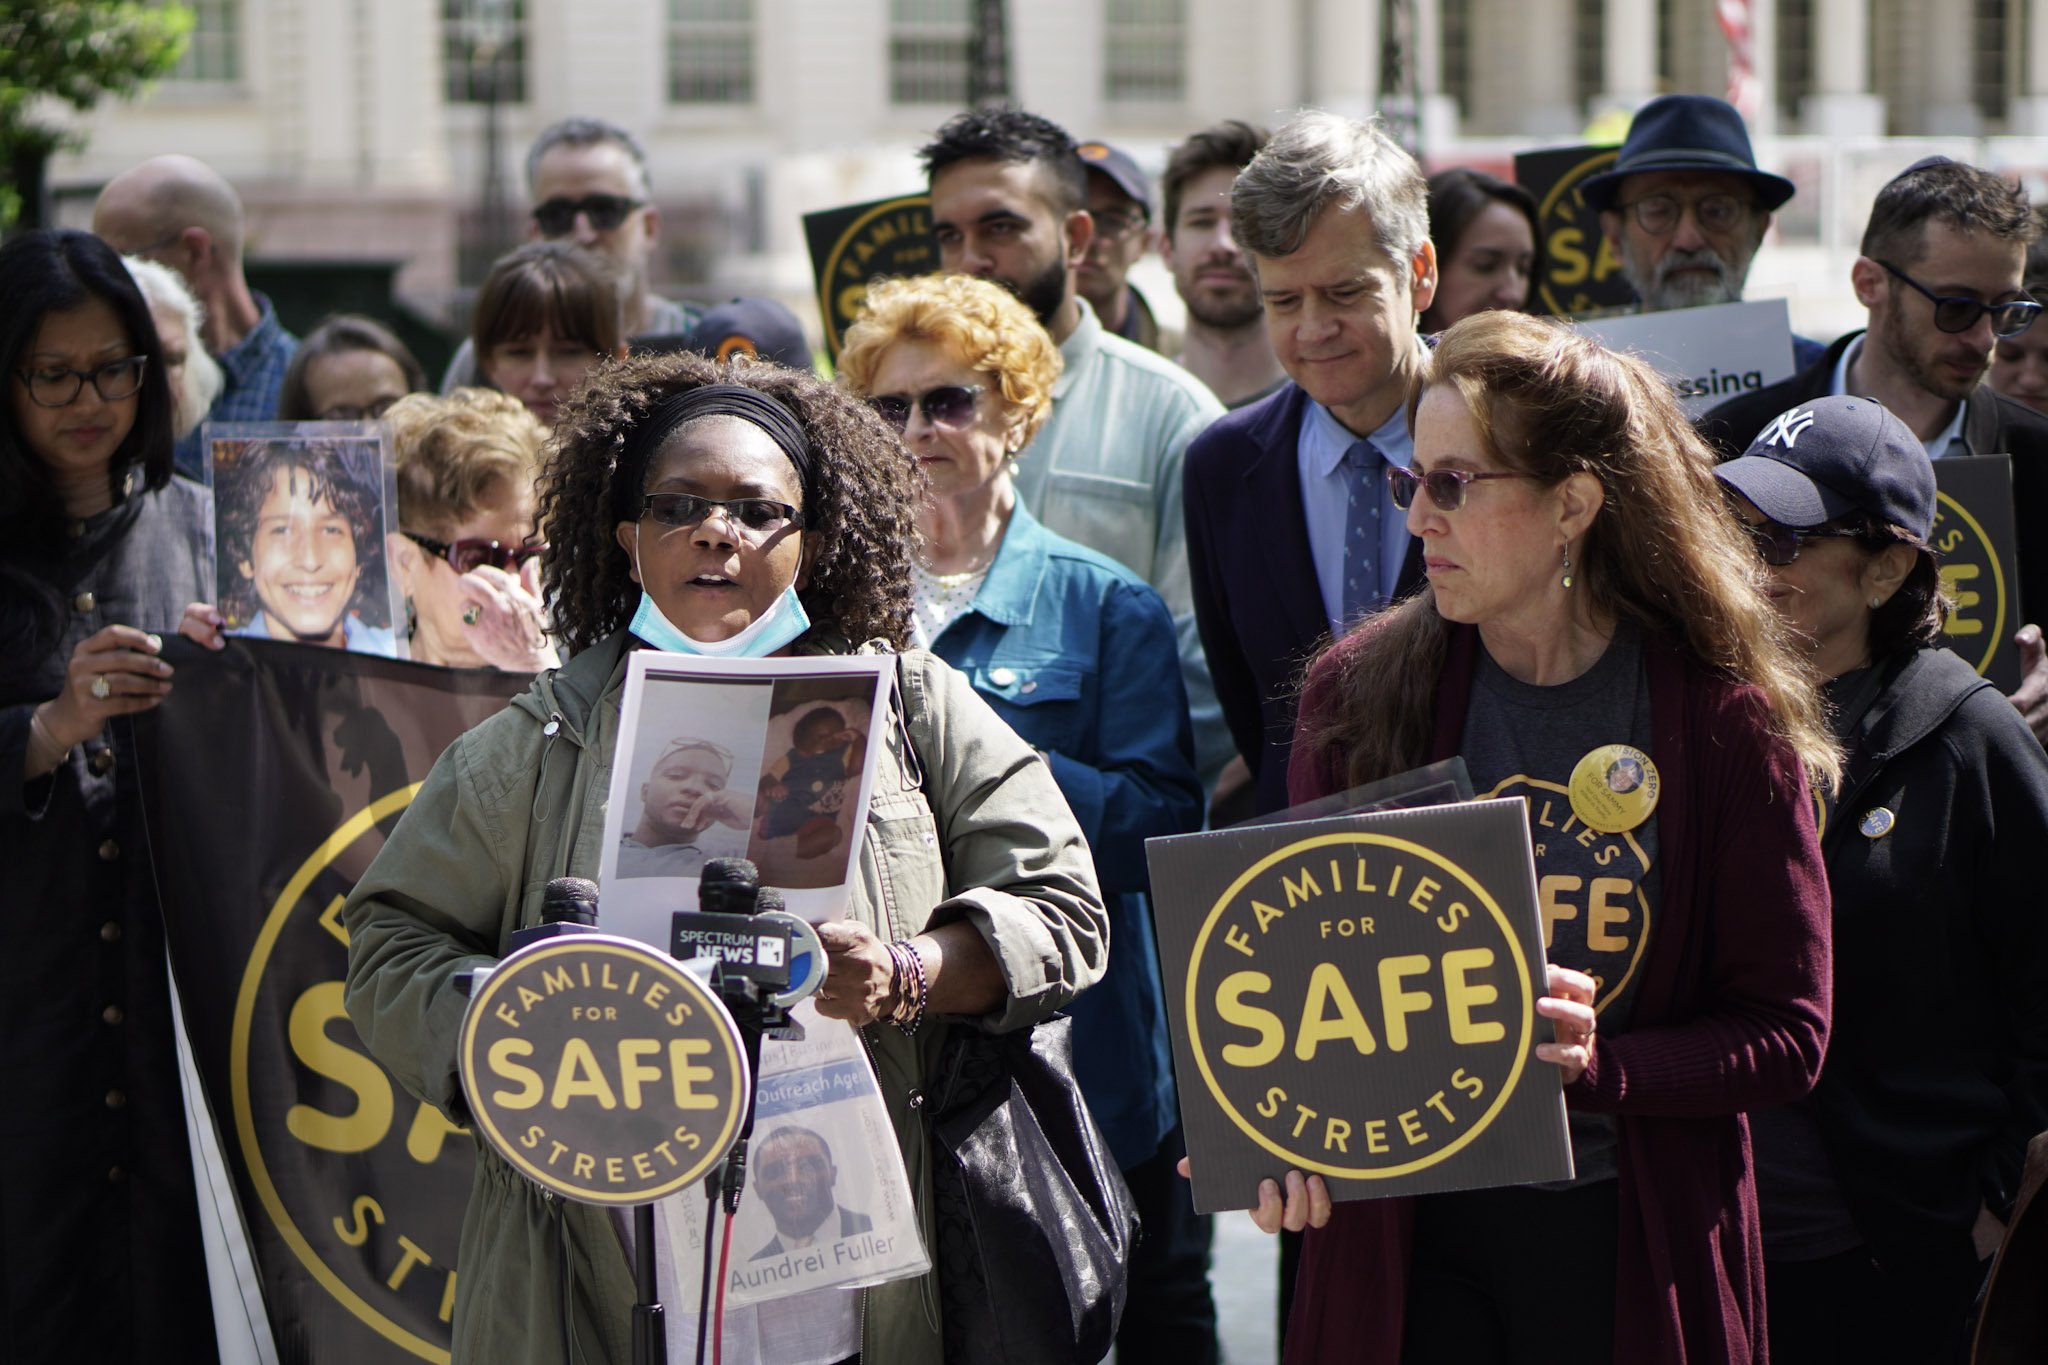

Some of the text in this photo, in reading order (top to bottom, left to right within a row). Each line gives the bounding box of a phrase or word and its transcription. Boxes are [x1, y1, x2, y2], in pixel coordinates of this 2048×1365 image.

[1756, 407, 1814, 449] NY
[1645, 767, 1657, 799] ZERO
[1865, 810, 1885, 834] SAFE
[1225, 859, 1471, 957] FAMILIES
[679, 930, 754, 947] SPECTRUM
[1320, 917, 1375, 938] FOR
[696, 944, 754, 964] NEWS
[773, 951, 780, 963] 1
[496, 963, 692, 1027] FAMILIES
[1215, 948, 1506, 1068] SAFE
[572, 1007, 617, 1021] FOR
[488, 1038, 719, 1109] SAFE
[756, 1076, 830, 1105] Outreach
[1257, 1068, 1485, 1154] STREETS
[520, 1126, 701, 1182] STREETS
[730, 1236, 895, 1293] Aundrei Fuller
